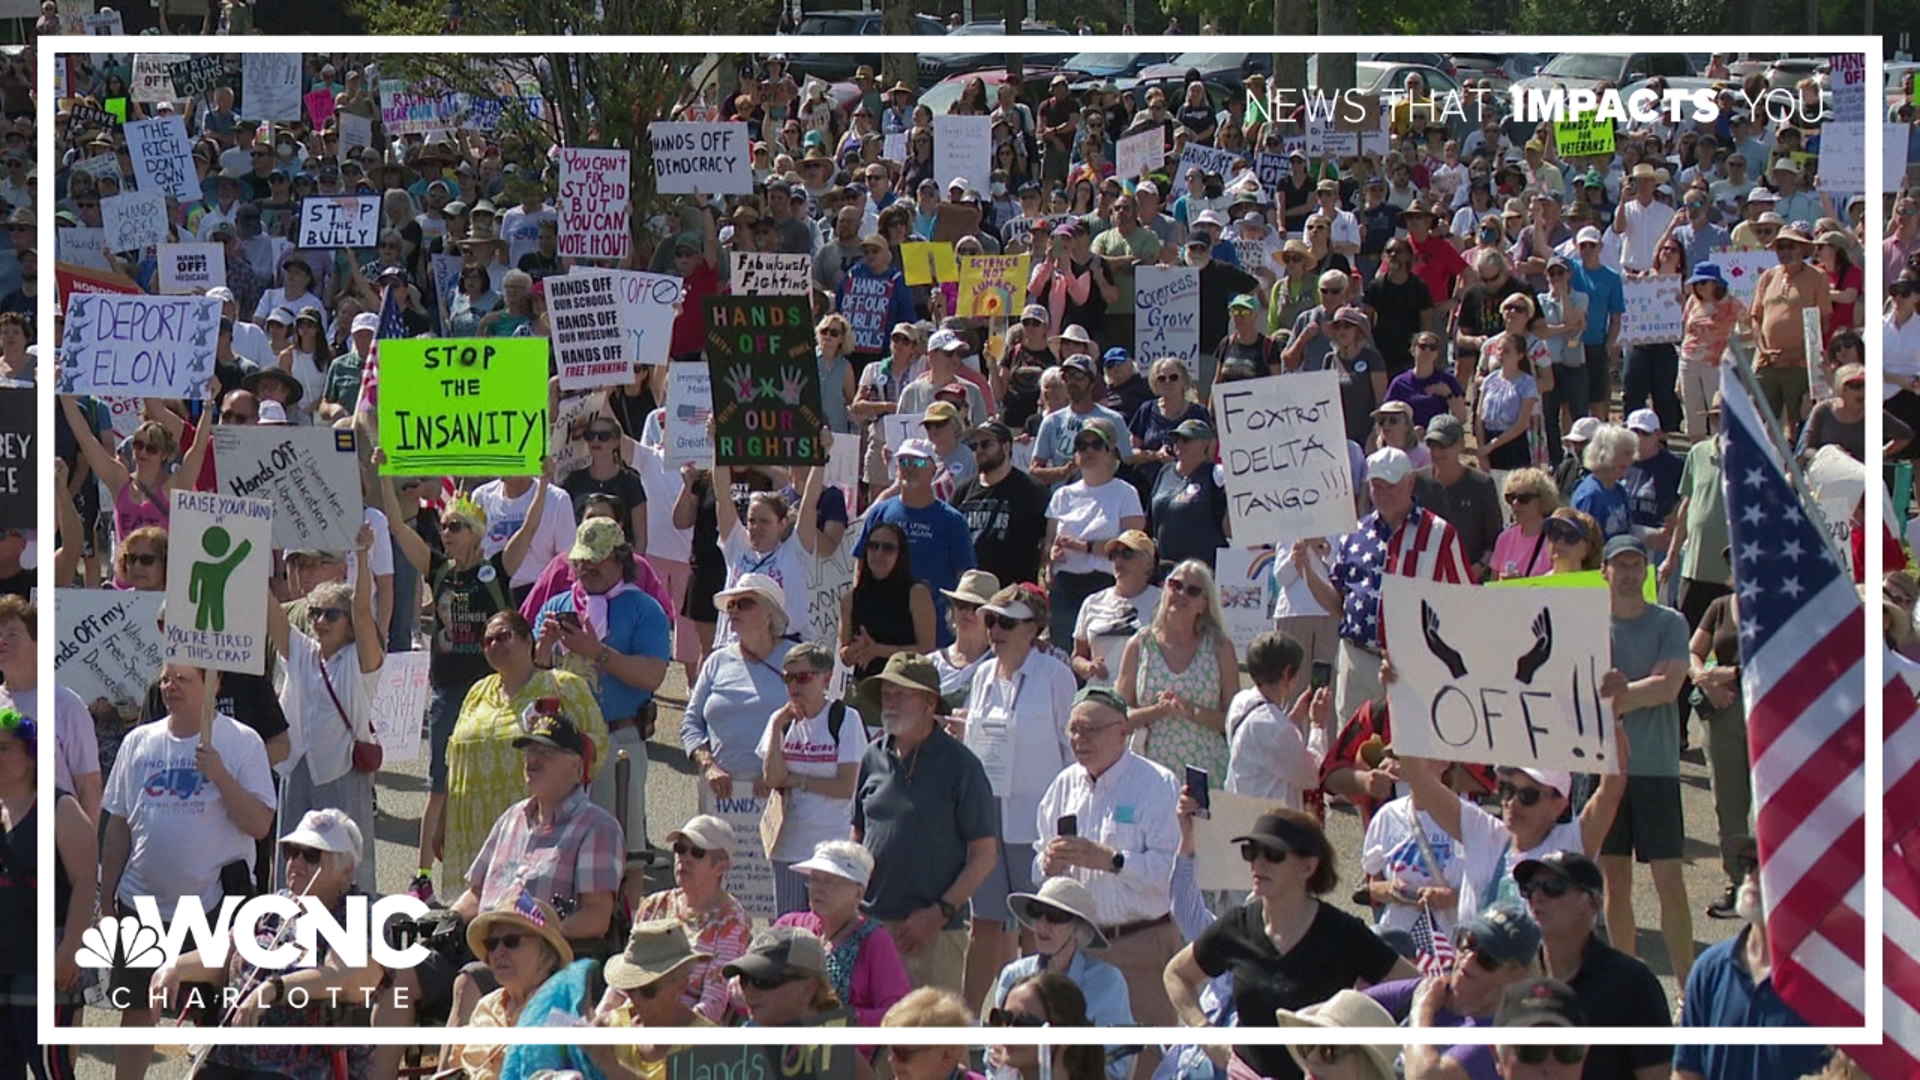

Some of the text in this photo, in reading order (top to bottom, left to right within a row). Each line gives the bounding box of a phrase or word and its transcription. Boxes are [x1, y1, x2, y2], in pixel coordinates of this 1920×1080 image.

[183, 78, 218, 97] OUT
[138, 121, 175, 138] THE
[141, 139, 181, 157] RICH
[652, 130, 735, 152] HANDS OFF
[564, 150, 591, 175] YOU
[656, 156, 737, 177] DEMOCRACY
[1181, 144, 1213, 169] HANDS
[153, 170, 185, 186] OWN
[585, 171, 605, 184] FIX
[161, 183, 187, 198] ME
[561, 180, 626, 201] STUPID
[572, 196, 611, 213] BUT
[329, 221, 354, 231] THE
[563, 211, 626, 232] YOU CAN
[306, 229, 369, 246] BULLY
[558, 233, 588, 256] VOTE
[176, 254, 207, 262] HANDS
[176, 261, 207, 272] OFF!
[970, 257, 1020, 269] SCIENCE
[175, 273, 210, 282] MEDICARE
[982, 267, 1007, 278] NOT
[551, 276, 612, 298] HANDS OFF
[851, 277, 888, 295] HANDS
[971, 279, 1018, 297] LUNACY
[553, 298, 573, 312] OUR
[841, 295, 890, 312] OFF OUR
[97, 299, 191, 343] DEPORT
[556, 310, 617, 331] HANDS OFF
[712, 305, 801, 327] HANDS
[1147, 305, 1195, 328] Grow
[558, 331, 577, 344] OUR
[739, 333, 782, 356] OFF
[1155, 326, 1166, 342] A
[424, 344, 496, 370] STOP
[561, 344, 622, 365] HANDS OFF
[92, 350, 176, 387] ELON
[565, 361, 628, 378] FREE THINKING
[440, 379, 481, 398] THE
[111, 397, 141, 416] OFF
[1223, 391, 1331, 435] FOXTROT
[744, 409, 794, 431] OUR
[394, 408, 548, 462] INSANITY!
[719, 435, 820, 460] RIGHTS!
[1229, 434, 1337, 477] DELTA
[228, 459, 276, 499] Hands
[178, 492, 272, 522] RAISE YOUR HAND
[273, 476, 312, 540] Libraries
[289, 467, 330, 531] Education
[73, 613, 102, 645] Off
[166, 624, 254, 649] YOU'RE TIRED
[102, 633, 126, 662] Free
[185, 644, 214, 661] THIS
[216, 648, 252, 664] CRAP
[716, 797, 761, 814] HANDS
